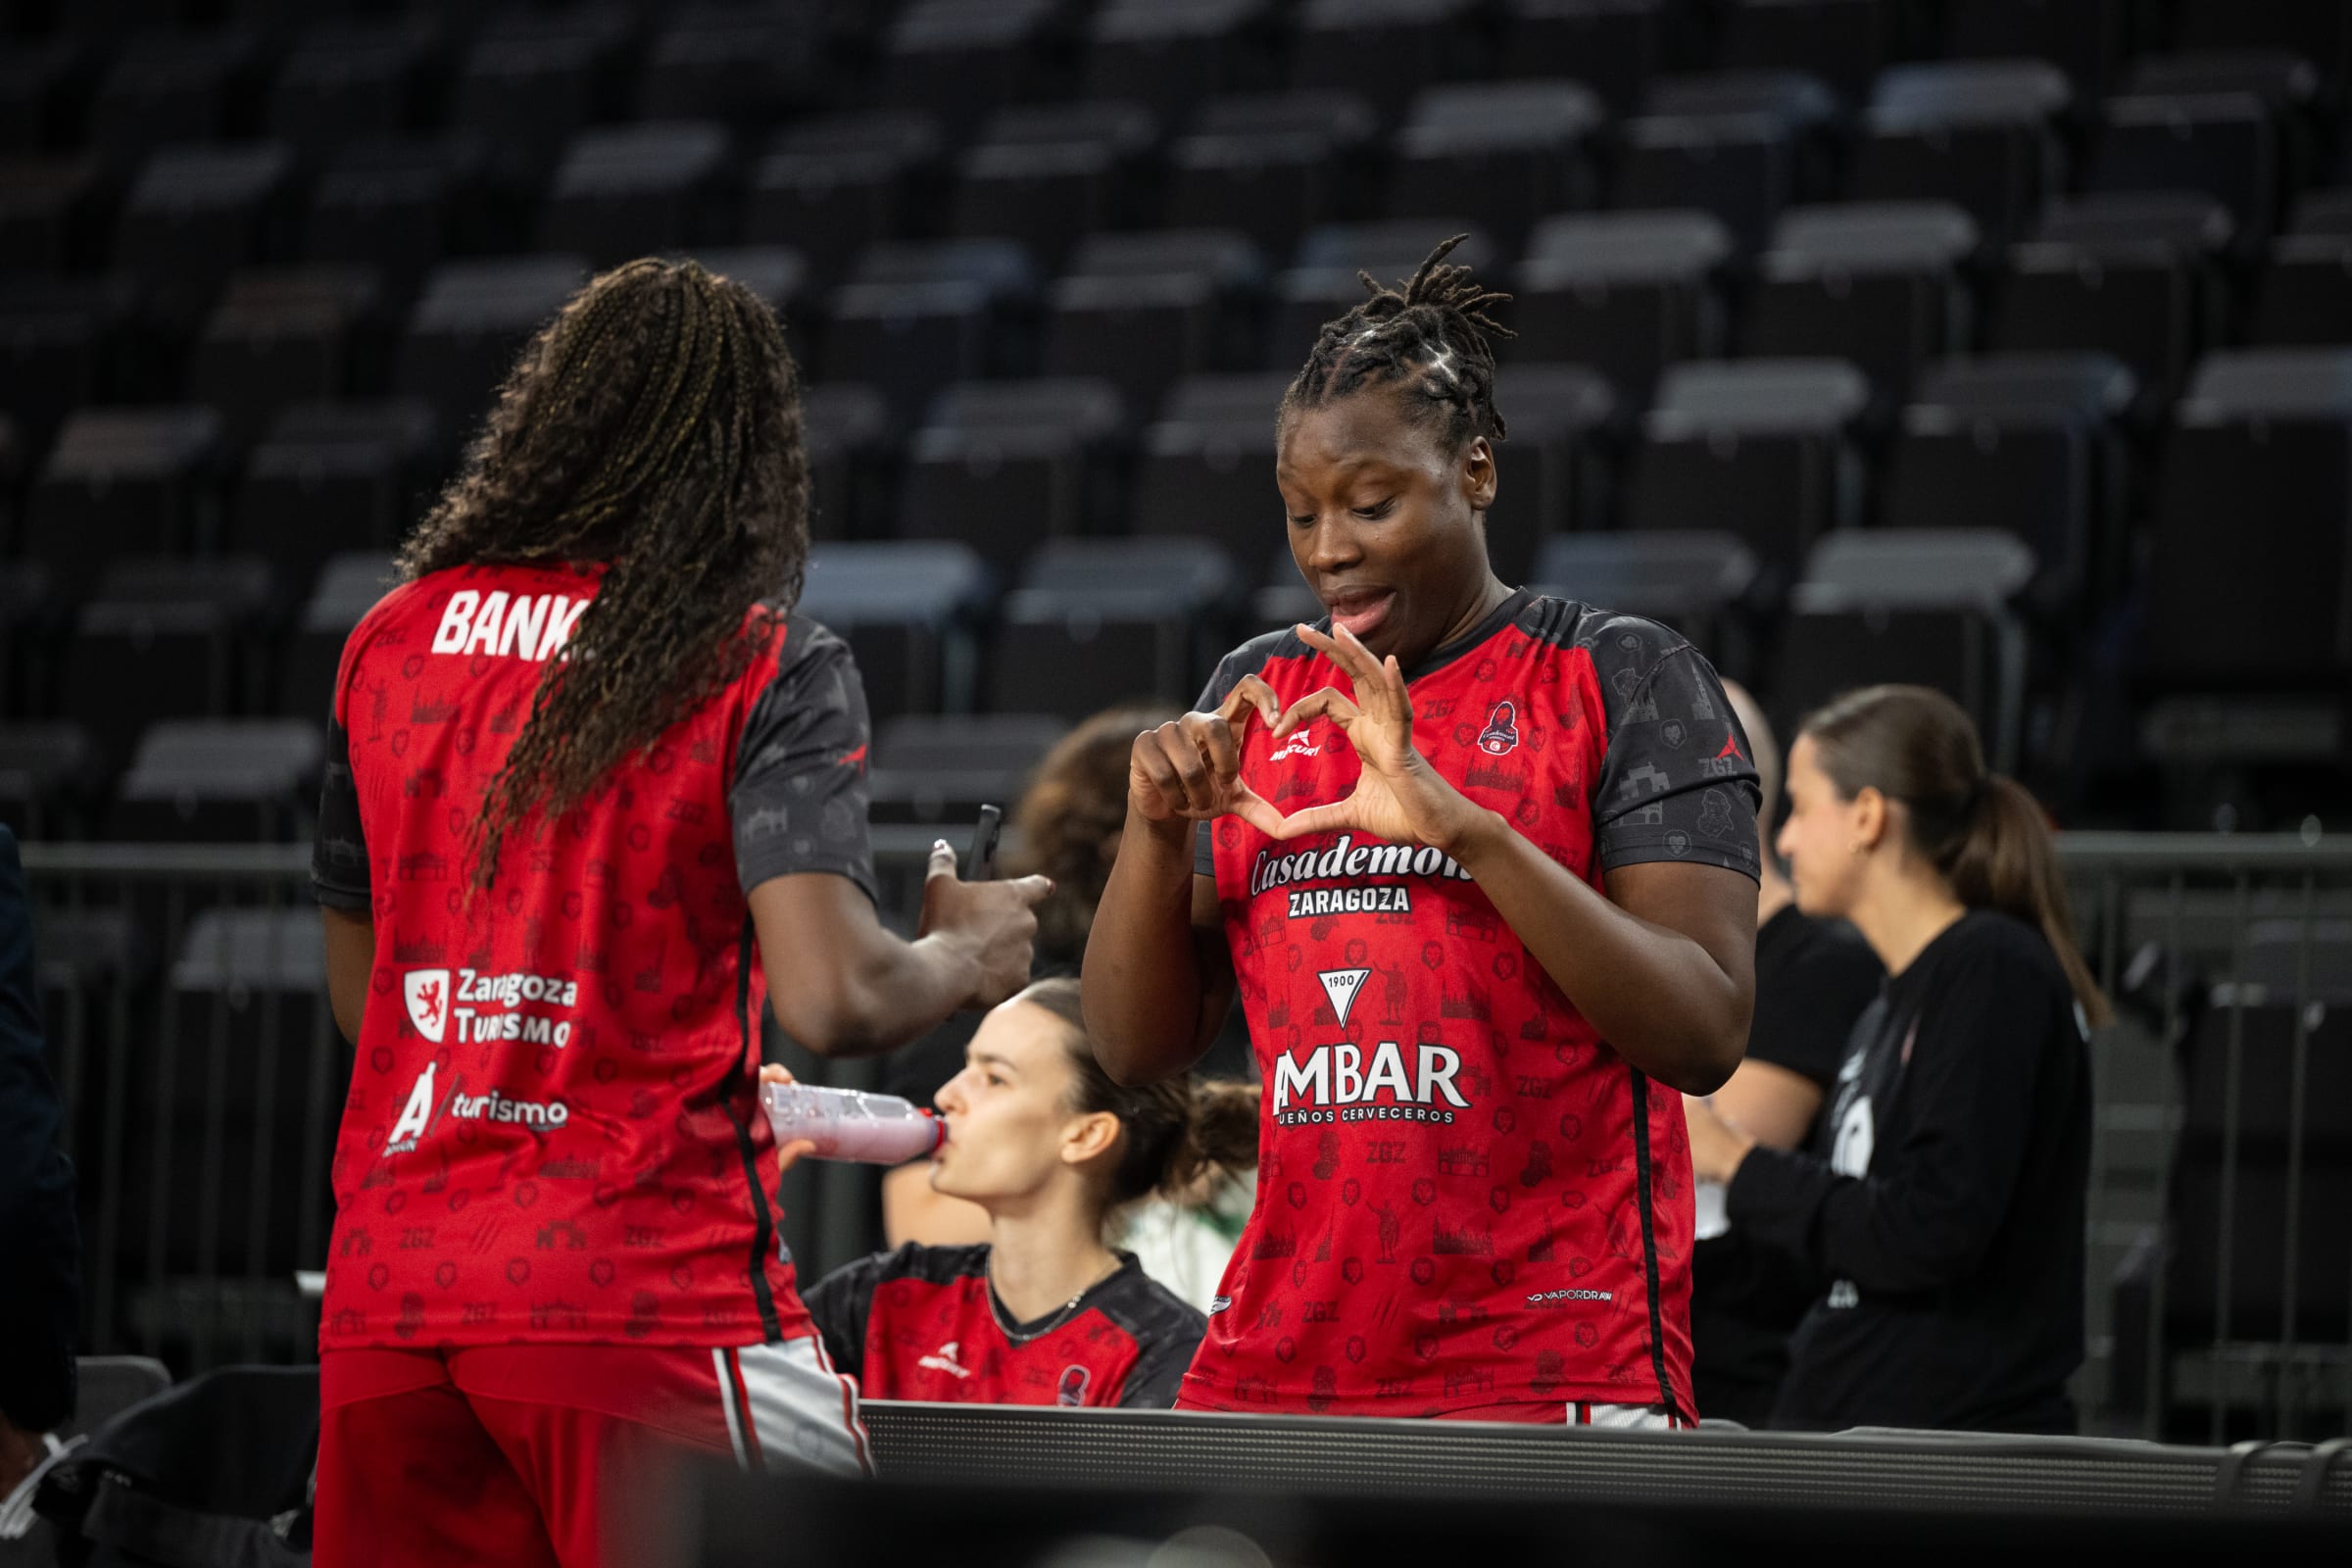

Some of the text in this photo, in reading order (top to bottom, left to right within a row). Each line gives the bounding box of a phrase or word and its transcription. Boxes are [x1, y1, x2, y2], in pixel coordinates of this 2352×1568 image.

[431, 590, 592, 661] BANK
[1250, 834, 1474, 897] Casademon
[1288, 887, 1410, 917] ZARAGOZA
[1328, 974, 1355, 988] 1900
[452, 1090, 568, 1123] turismo
[1279, 1106, 1454, 1125] UEÑOS CERVECEROS
[1365, 1141, 1407, 1164] ZGZ
[399, 1227, 435, 1250] ZGZ
[1301, 1300, 1341, 1323] ZGZ
